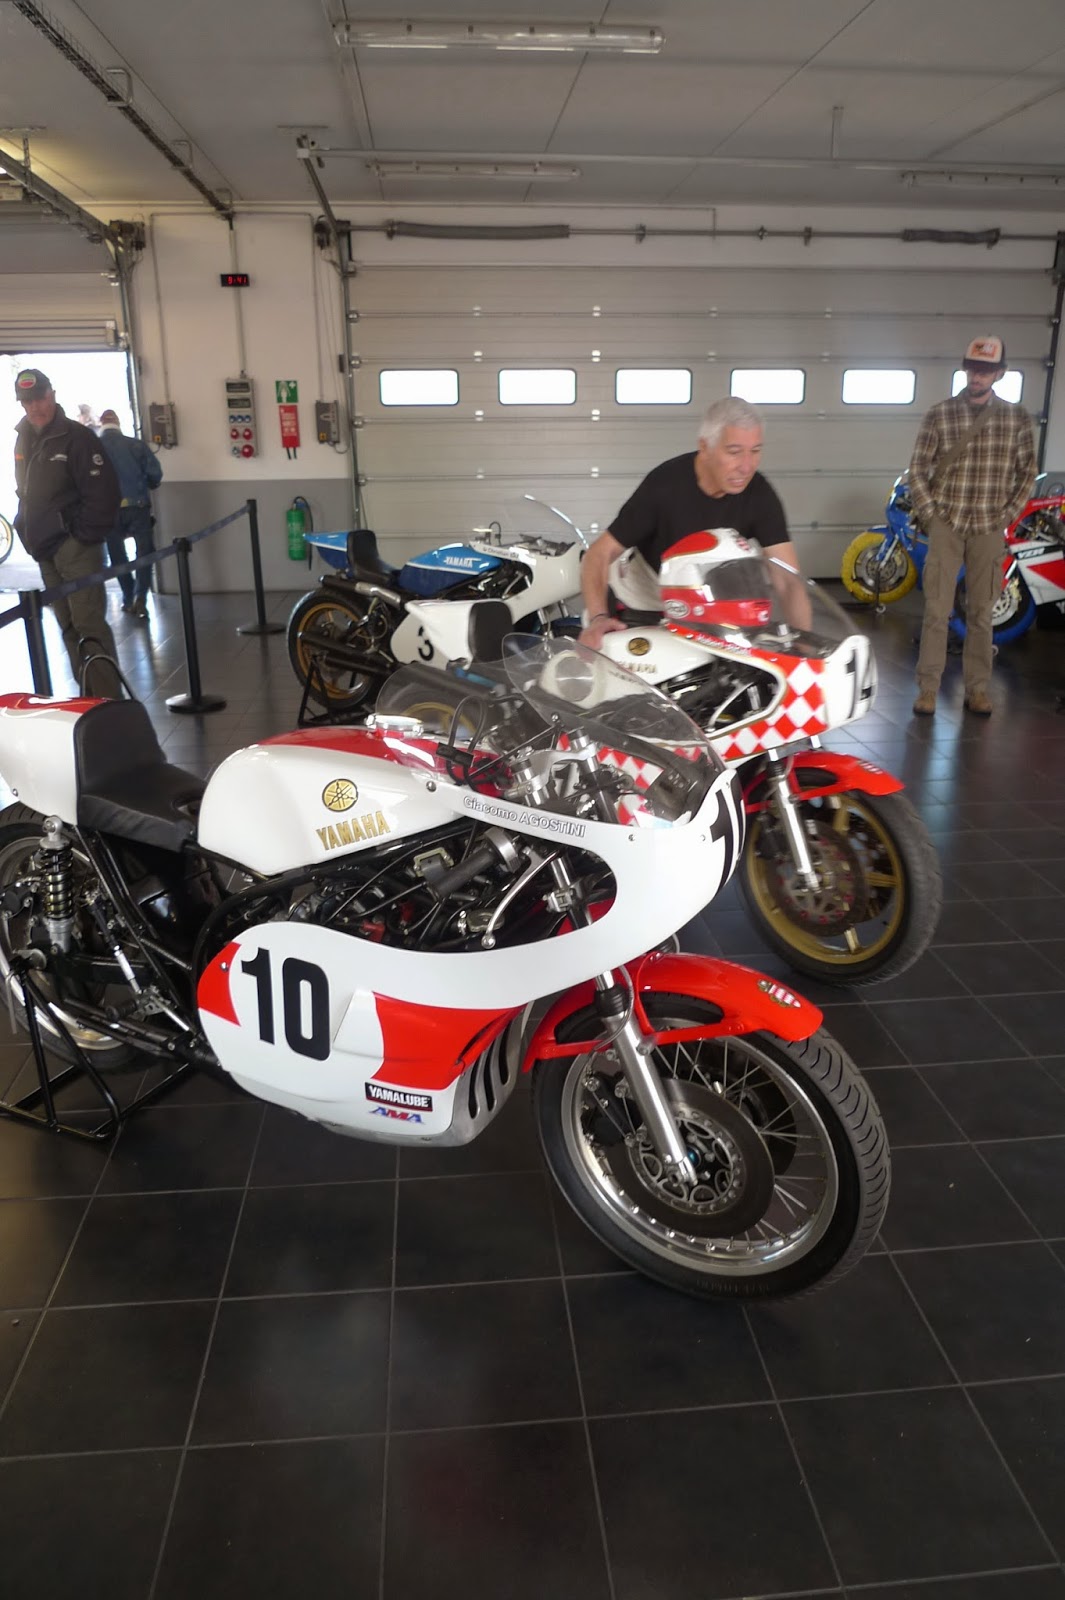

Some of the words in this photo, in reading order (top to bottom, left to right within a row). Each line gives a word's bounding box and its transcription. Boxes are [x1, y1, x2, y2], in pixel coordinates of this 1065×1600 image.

[443, 556, 473, 568] YAMAHA
[417, 625, 434, 661] 3
[315, 811, 391, 850] YAMAHA
[463, 795, 518, 822] Giacomo
[518, 811, 587, 838] AGOSTINI
[241, 946, 331, 1061] 10
[368, 1084, 431, 1108] YAMALUBE
[369, 1106, 426, 1125] AMA
